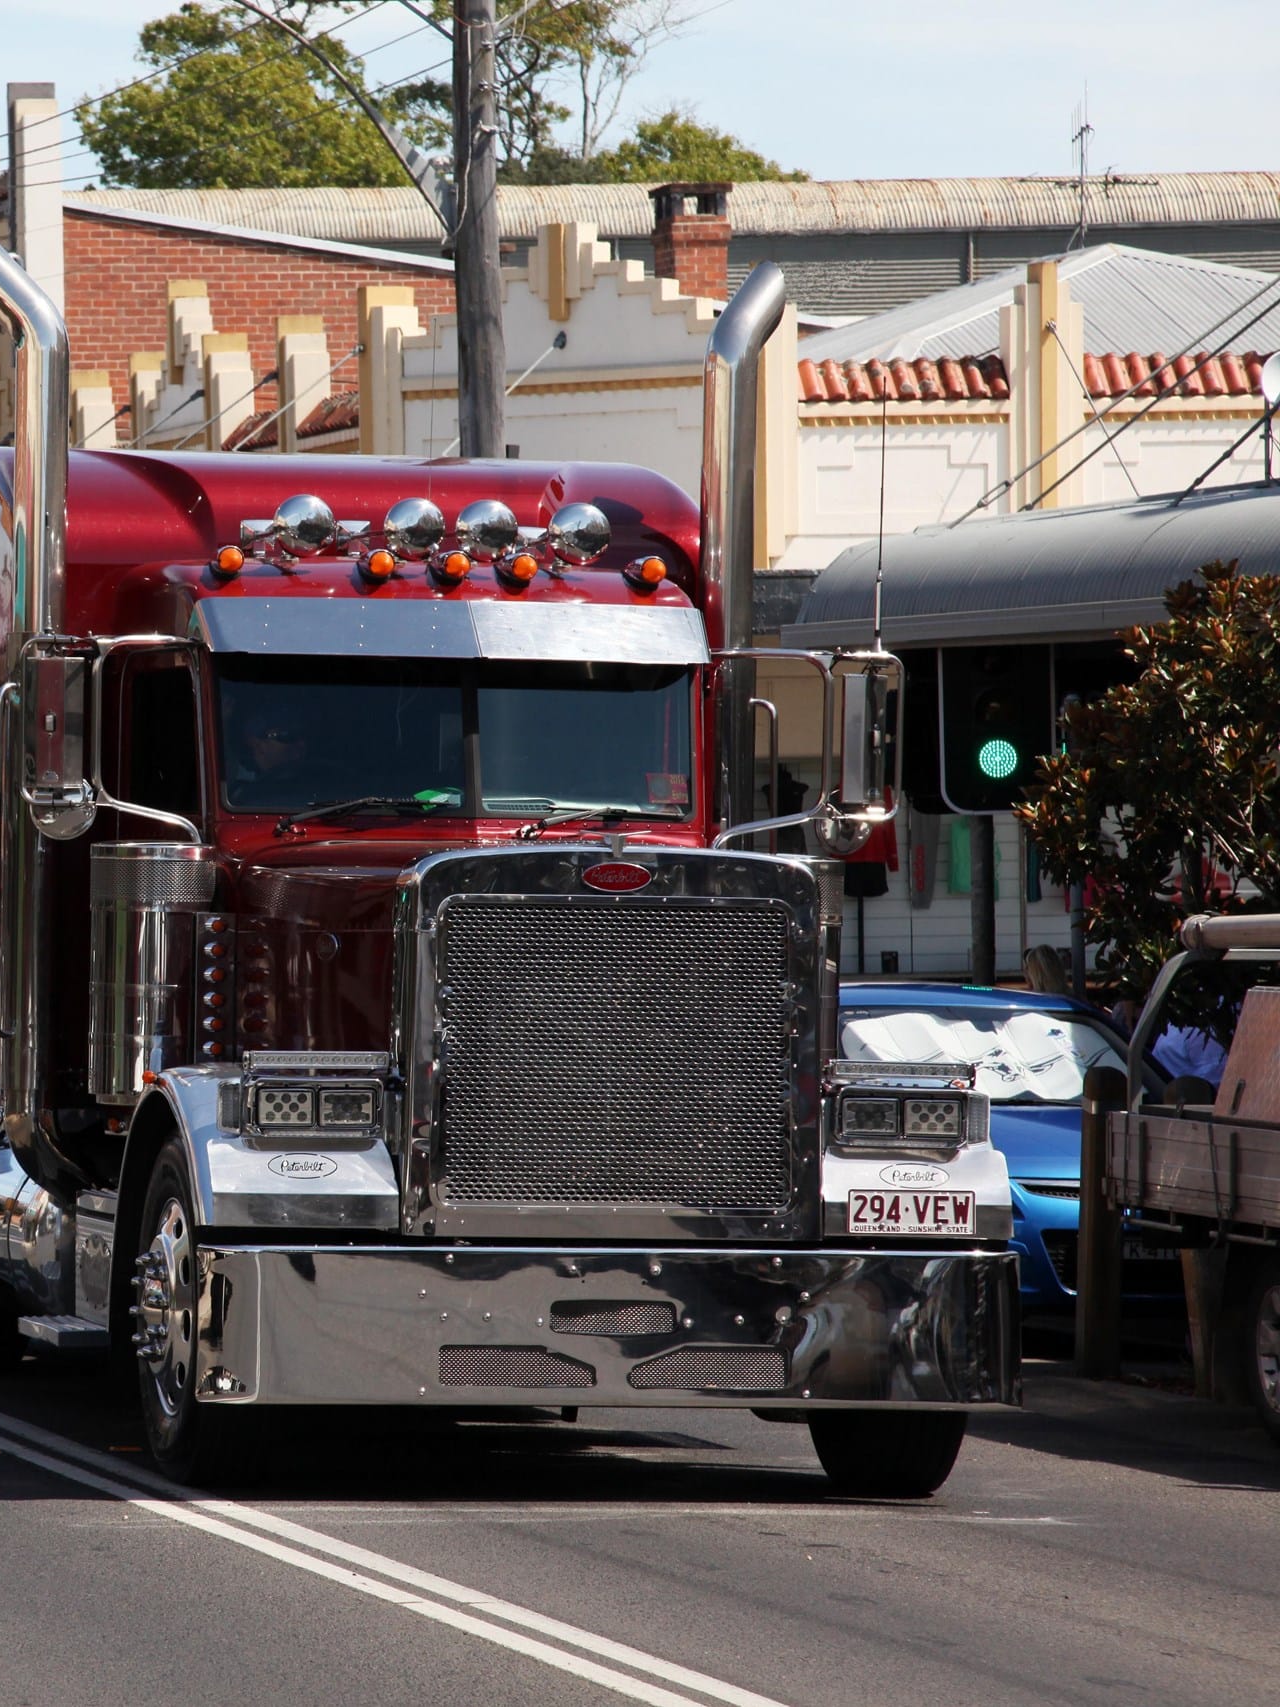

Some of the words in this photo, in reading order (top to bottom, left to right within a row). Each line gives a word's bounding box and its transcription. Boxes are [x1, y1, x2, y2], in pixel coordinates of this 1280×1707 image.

[591, 868, 640, 883] Peterbilt
[281, 1159, 327, 1173] Peterbilt
[892, 1169, 939, 1182] Peterbilt
